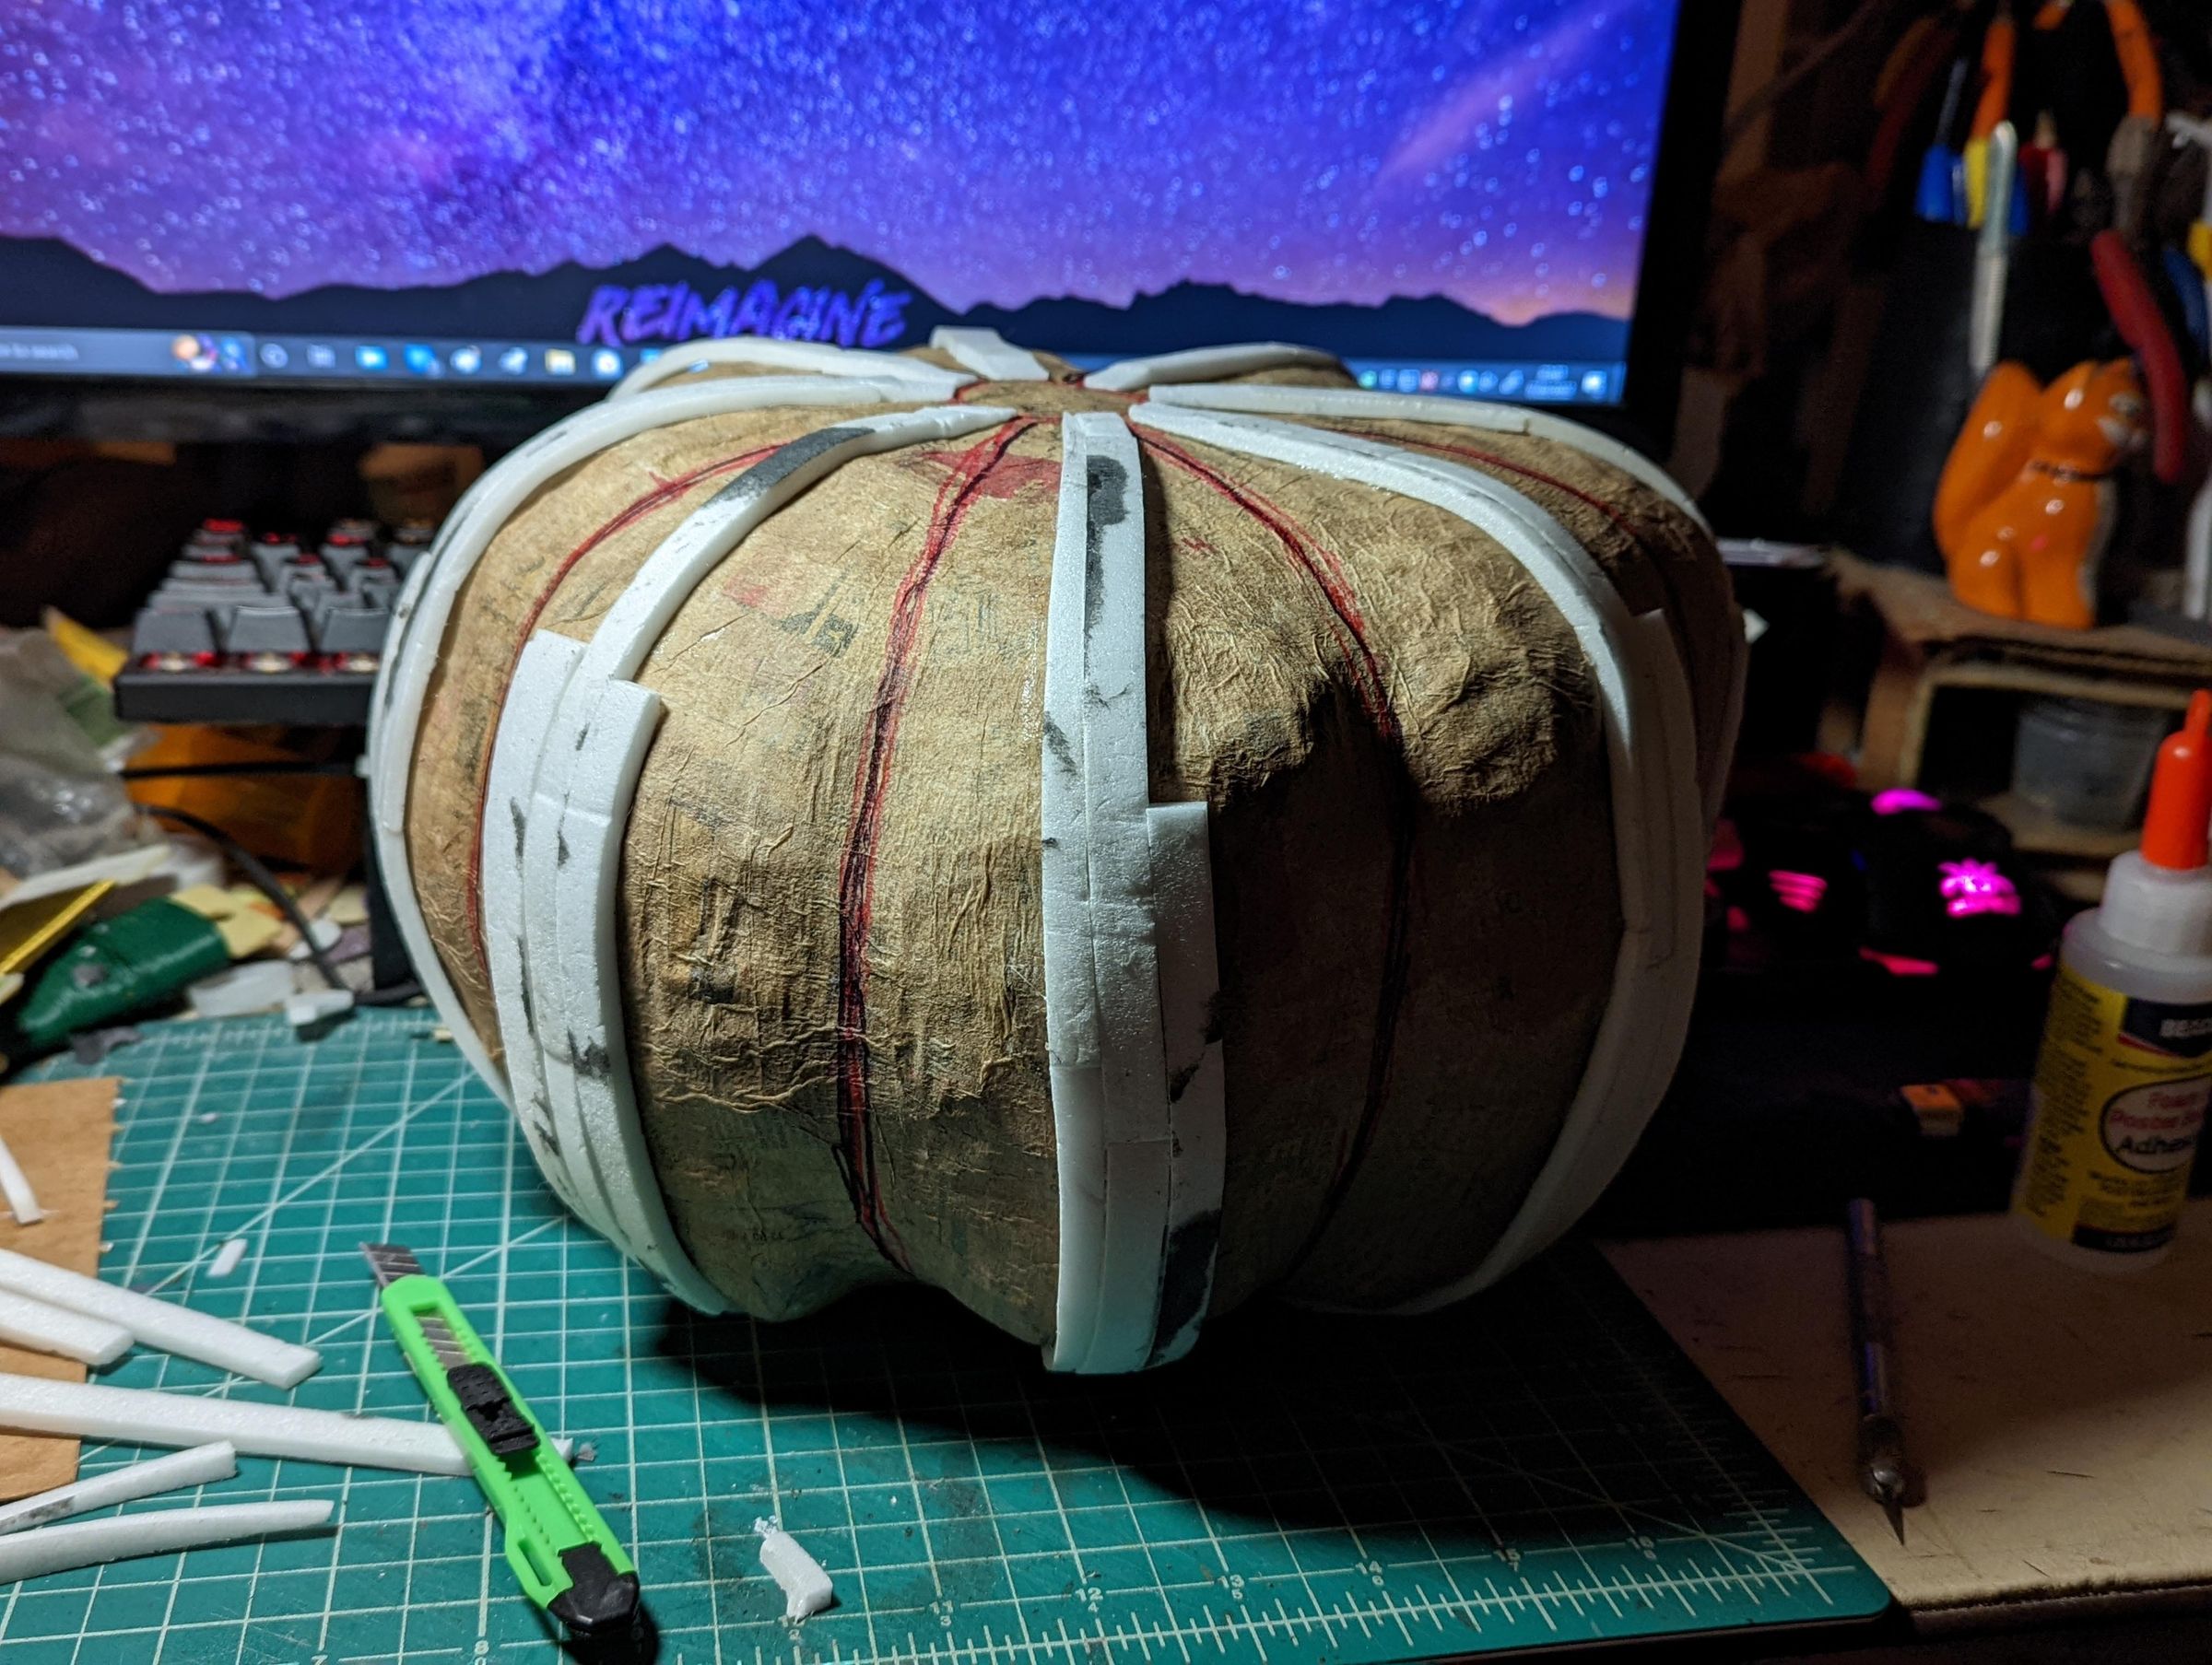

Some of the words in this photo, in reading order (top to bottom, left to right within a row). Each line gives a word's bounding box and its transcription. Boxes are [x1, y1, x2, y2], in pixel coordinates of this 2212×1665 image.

[575, 278, 913, 348] REIMAGINE
[1355, 1560, 1382, 1575] 14
[1217, 1574, 1244, 1589] 13
[1075, 1587, 1104, 1602] 12
[1230, 1588, 1243, 1600] 5
[929, 1600, 954, 1614] 11
[1087, 1601, 1100, 1612] 4
[940, 1614, 952, 1627] 3
[474, 1639, 490, 1655] 8
[311, 1654, 329, 1665] 7
